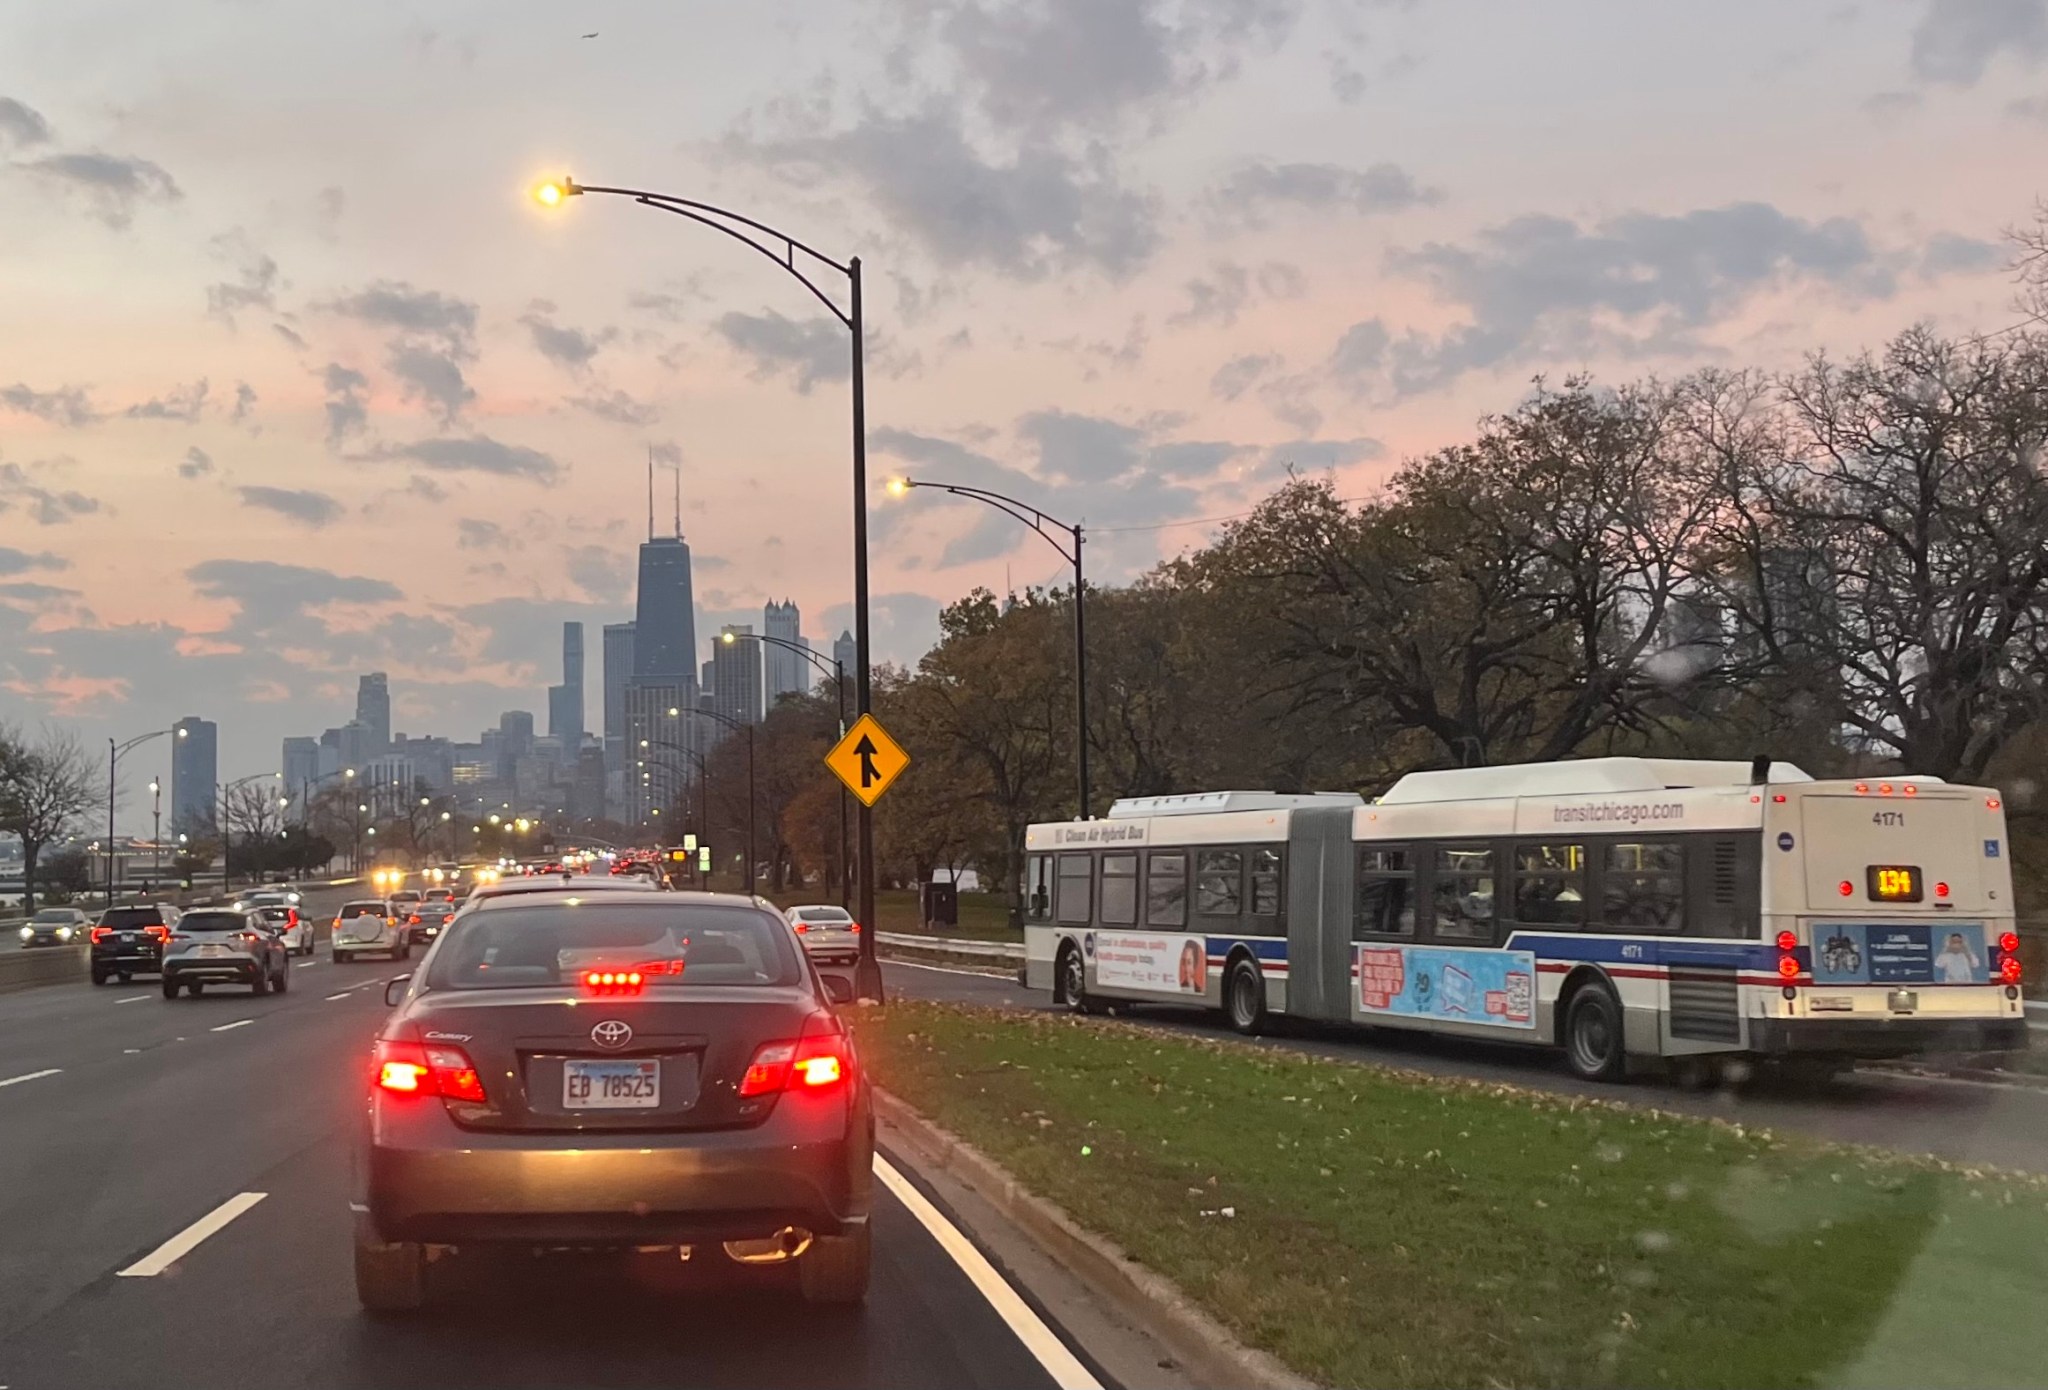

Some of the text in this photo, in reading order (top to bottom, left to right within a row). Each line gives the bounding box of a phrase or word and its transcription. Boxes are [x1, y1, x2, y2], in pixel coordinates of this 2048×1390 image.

[1554, 801, 1684, 825] transitchicago.com
[1872, 812, 1904, 827] 4171
[1879, 870, 1911, 894] 134
[1621, 944, 1643, 958] 4171
[425, 1031, 473, 1042] Camry
[568, 1074, 655, 1098] EB 78525
